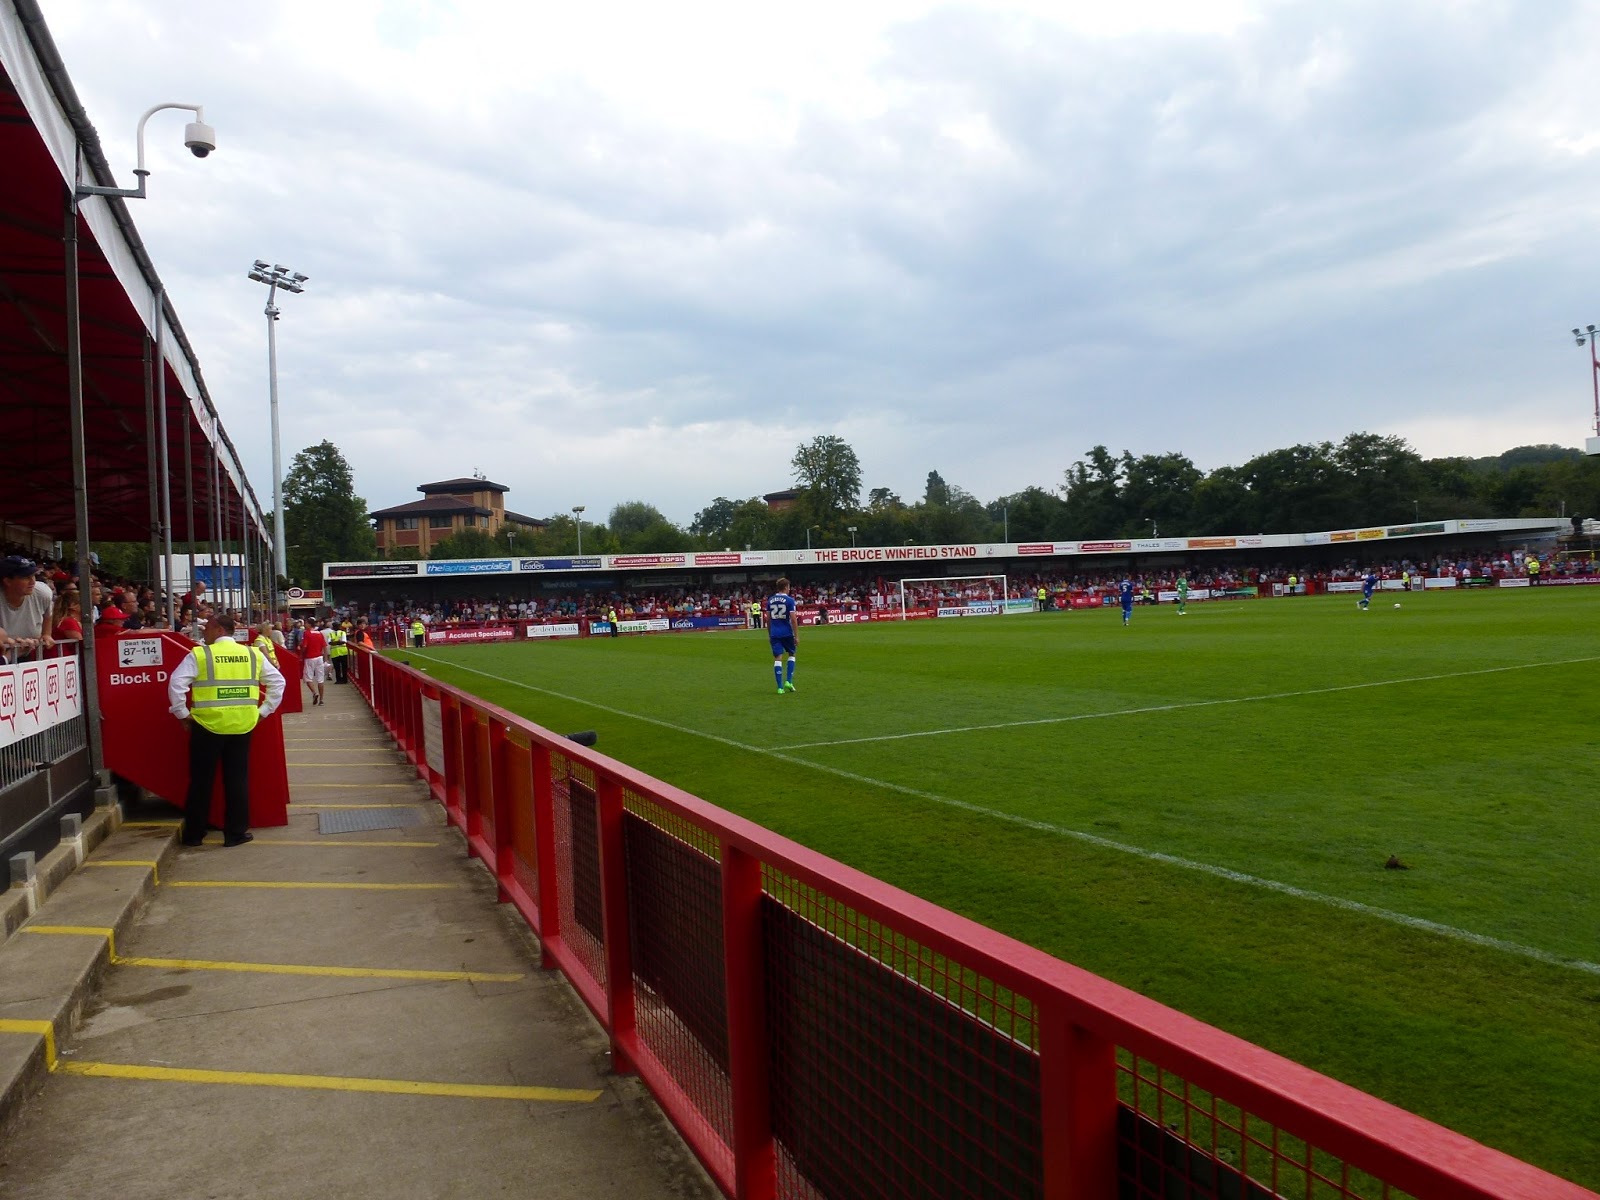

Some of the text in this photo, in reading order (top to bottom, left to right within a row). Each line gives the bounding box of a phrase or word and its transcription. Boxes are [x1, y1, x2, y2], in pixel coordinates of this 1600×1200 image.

[815, 546, 976, 561] THE BRUCE WINFIELD STAND
[521, 562, 545, 570] Leaders
[770, 604, 786, 619] 22
[449, 630, 477, 638] Accident
[123, 647, 157, 656] 87-114
[49, 674, 57, 694] GFS
[110, 671, 168, 685] Block D
[2, 684, 13, 707] GFS
[25, 680, 36, 701] GFS
